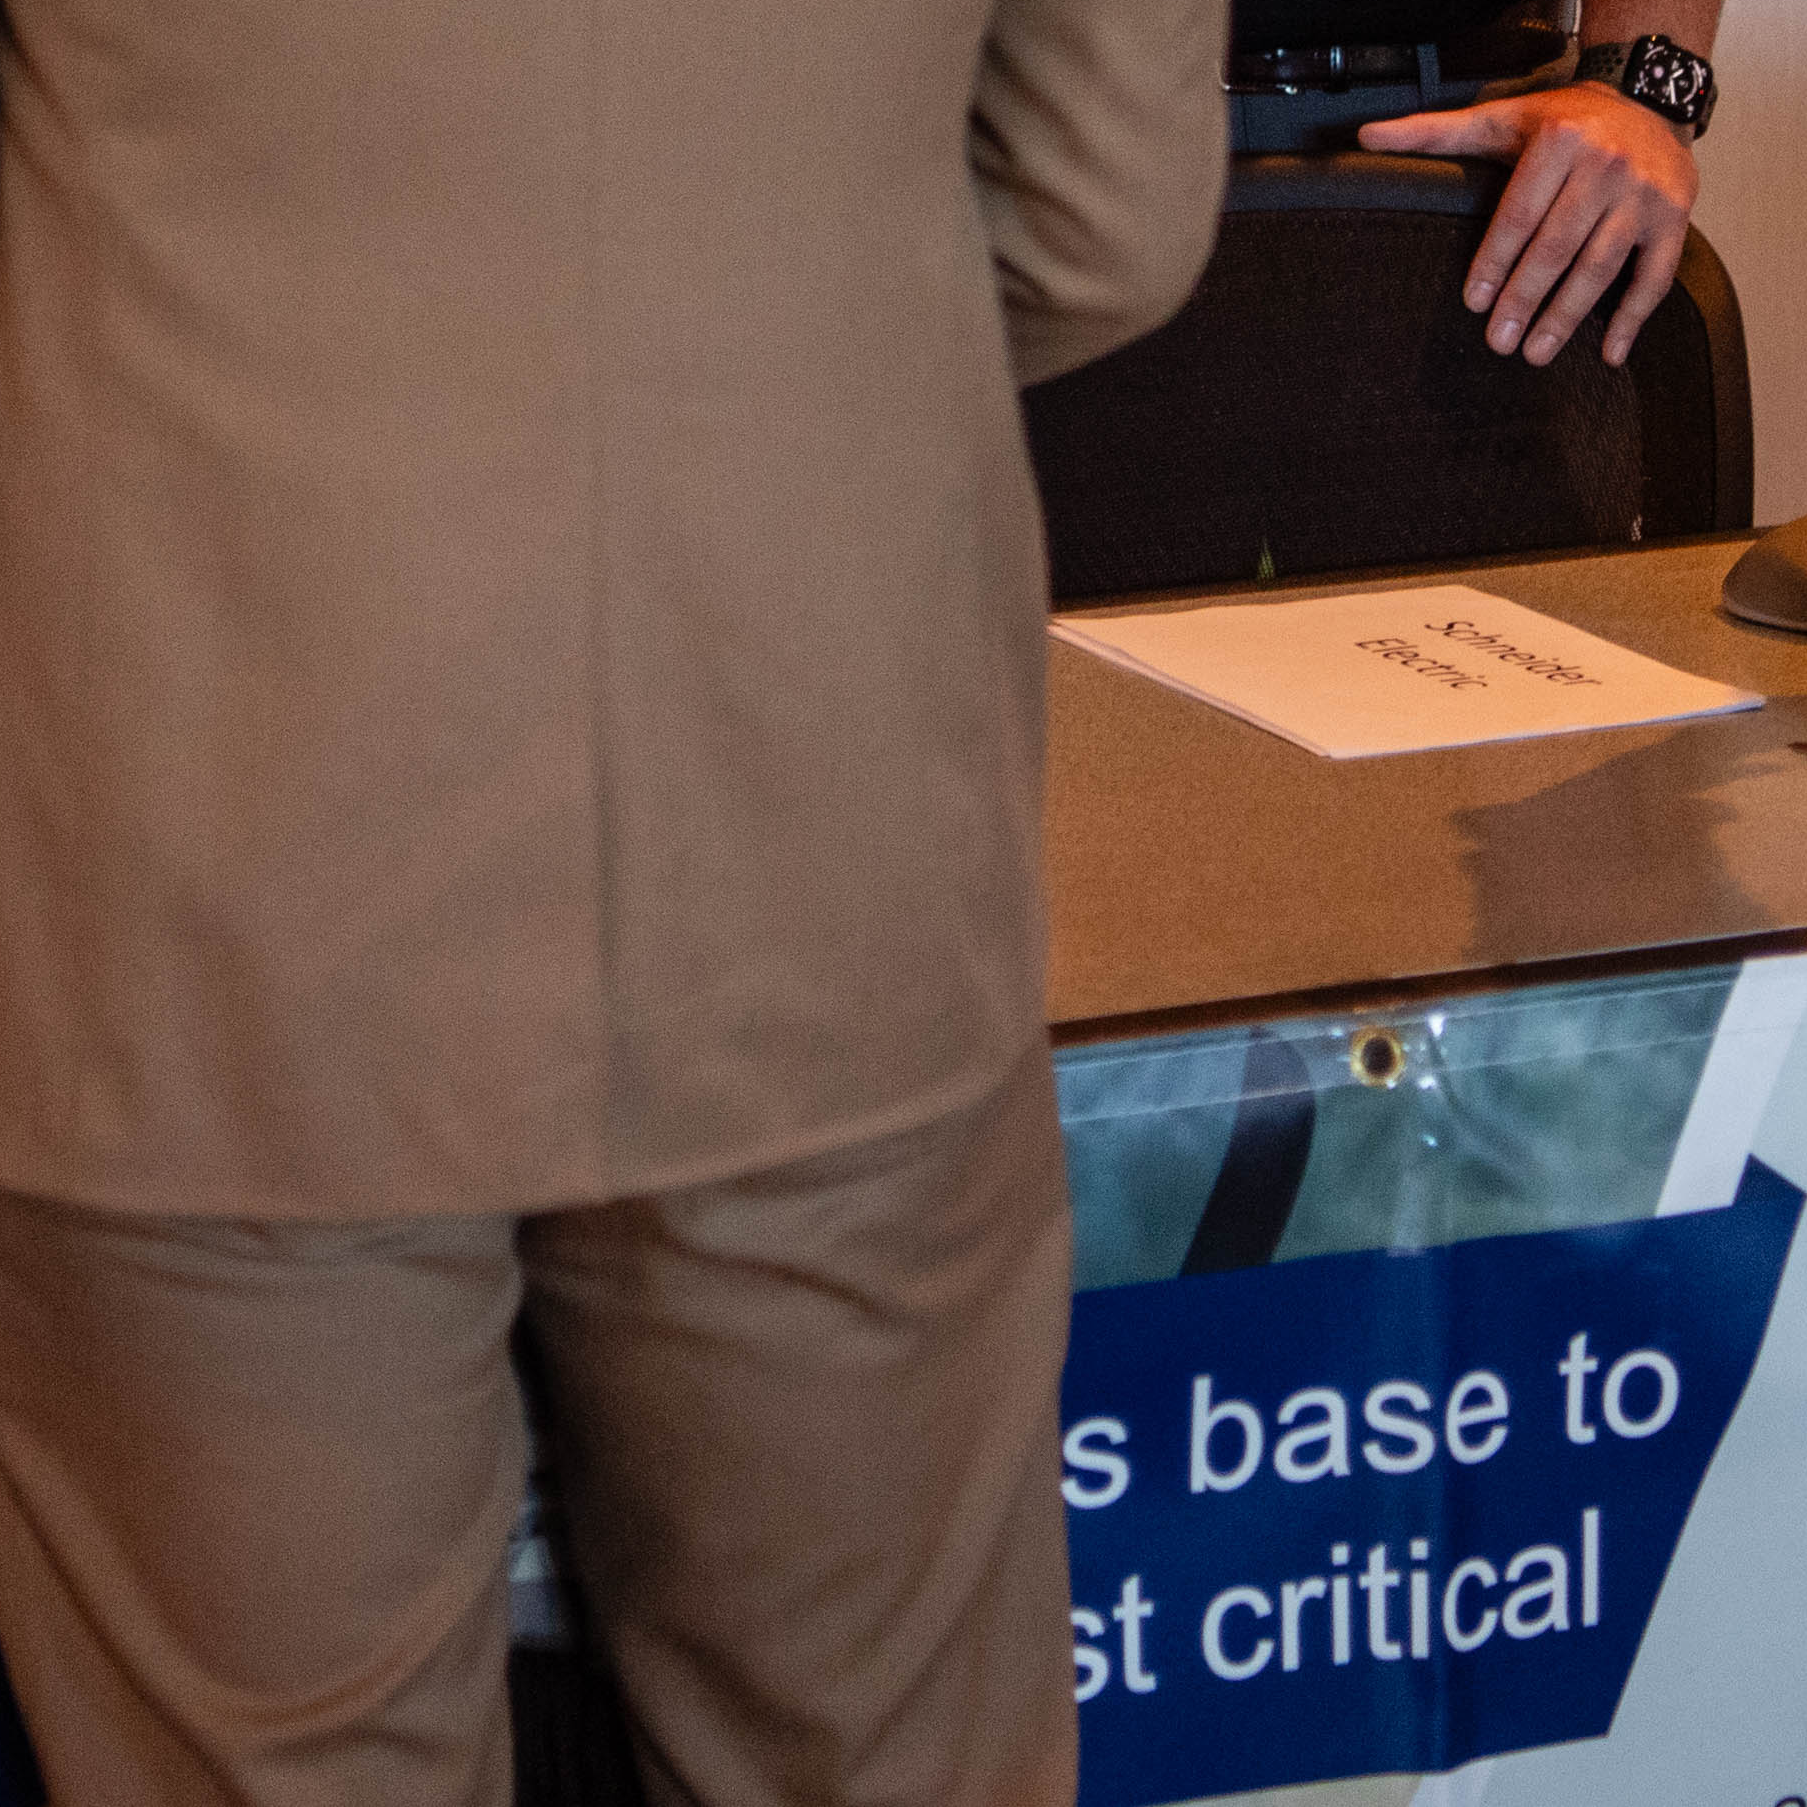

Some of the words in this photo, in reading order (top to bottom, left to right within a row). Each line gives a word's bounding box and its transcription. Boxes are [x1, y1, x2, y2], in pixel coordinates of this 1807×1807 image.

[1354, 637, 1488, 690] Electric
[1424, 620, 1602, 687] Schneider
[1189, 1372, 1510, 1495] base
[1559, 1331, 1680, 1446] to
[1201, 1507, 1600, 1681] critical
